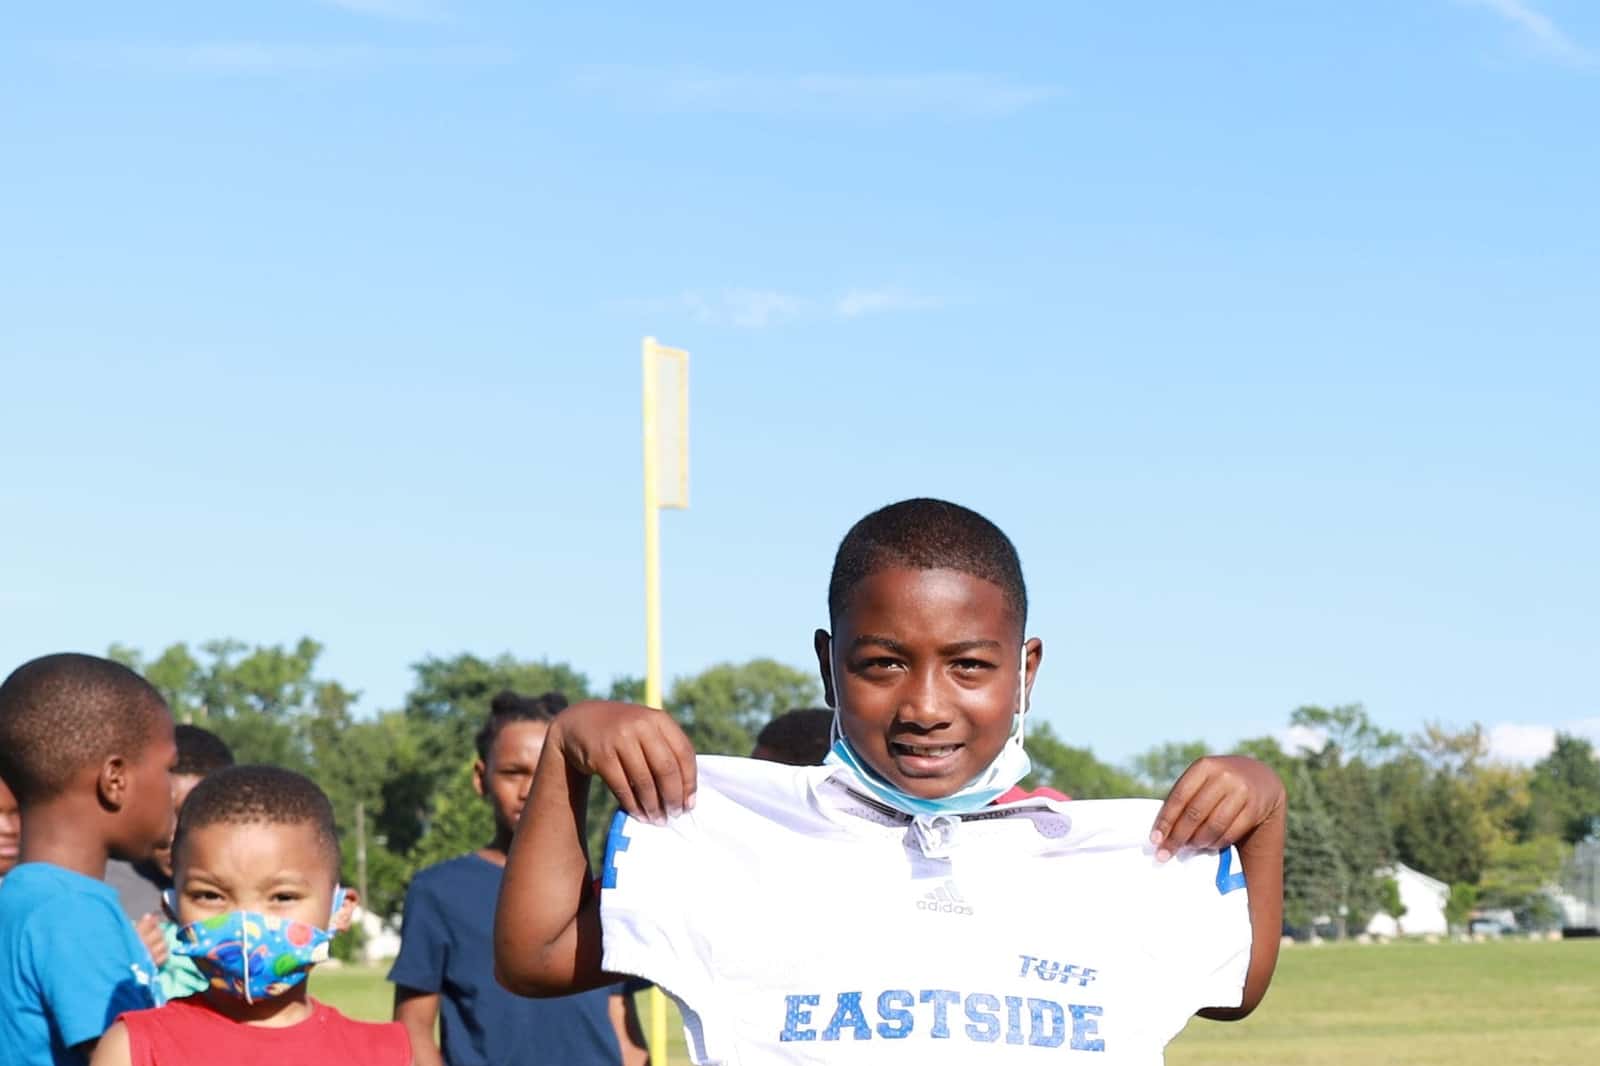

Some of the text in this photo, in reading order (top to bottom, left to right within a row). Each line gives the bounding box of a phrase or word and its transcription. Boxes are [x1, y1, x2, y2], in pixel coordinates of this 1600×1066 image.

[916, 899, 974, 916] adidas
[1018, 954, 1099, 987] TUFF
[779, 989, 1106, 1052] EASTSIDE
